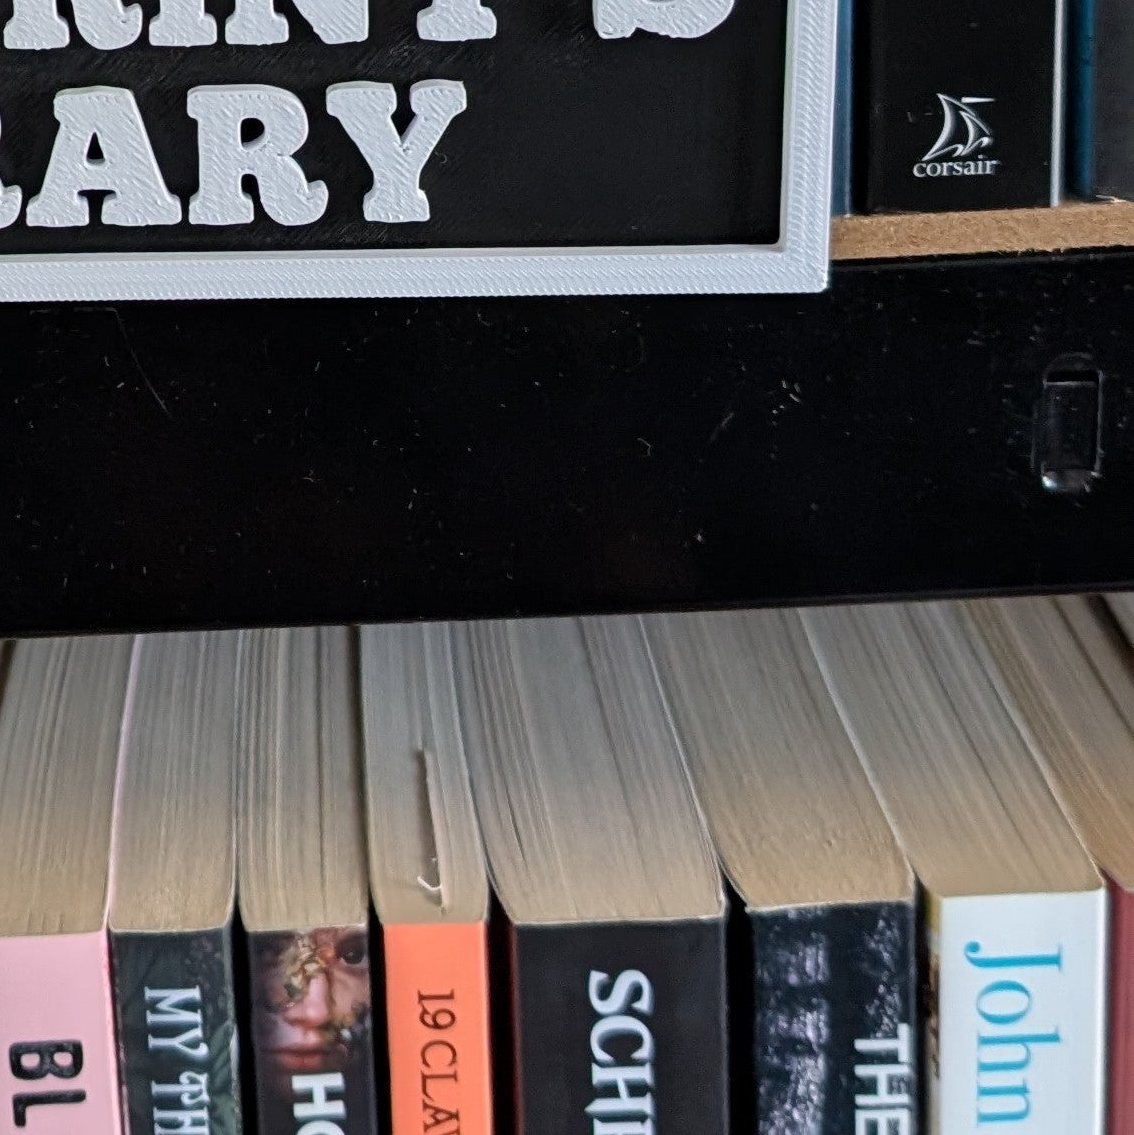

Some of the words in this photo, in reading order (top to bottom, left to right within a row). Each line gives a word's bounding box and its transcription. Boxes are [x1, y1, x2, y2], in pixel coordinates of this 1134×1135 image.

[913, 158, 999, 178] corsair
[144, 985, 209, 1062] MY
[417, 989, 456, 1031] 19
[965, 940, 1062, 1128] John
[9, 1040, 87, 1128] BL
[854, 1023, 910, 1135] THE
